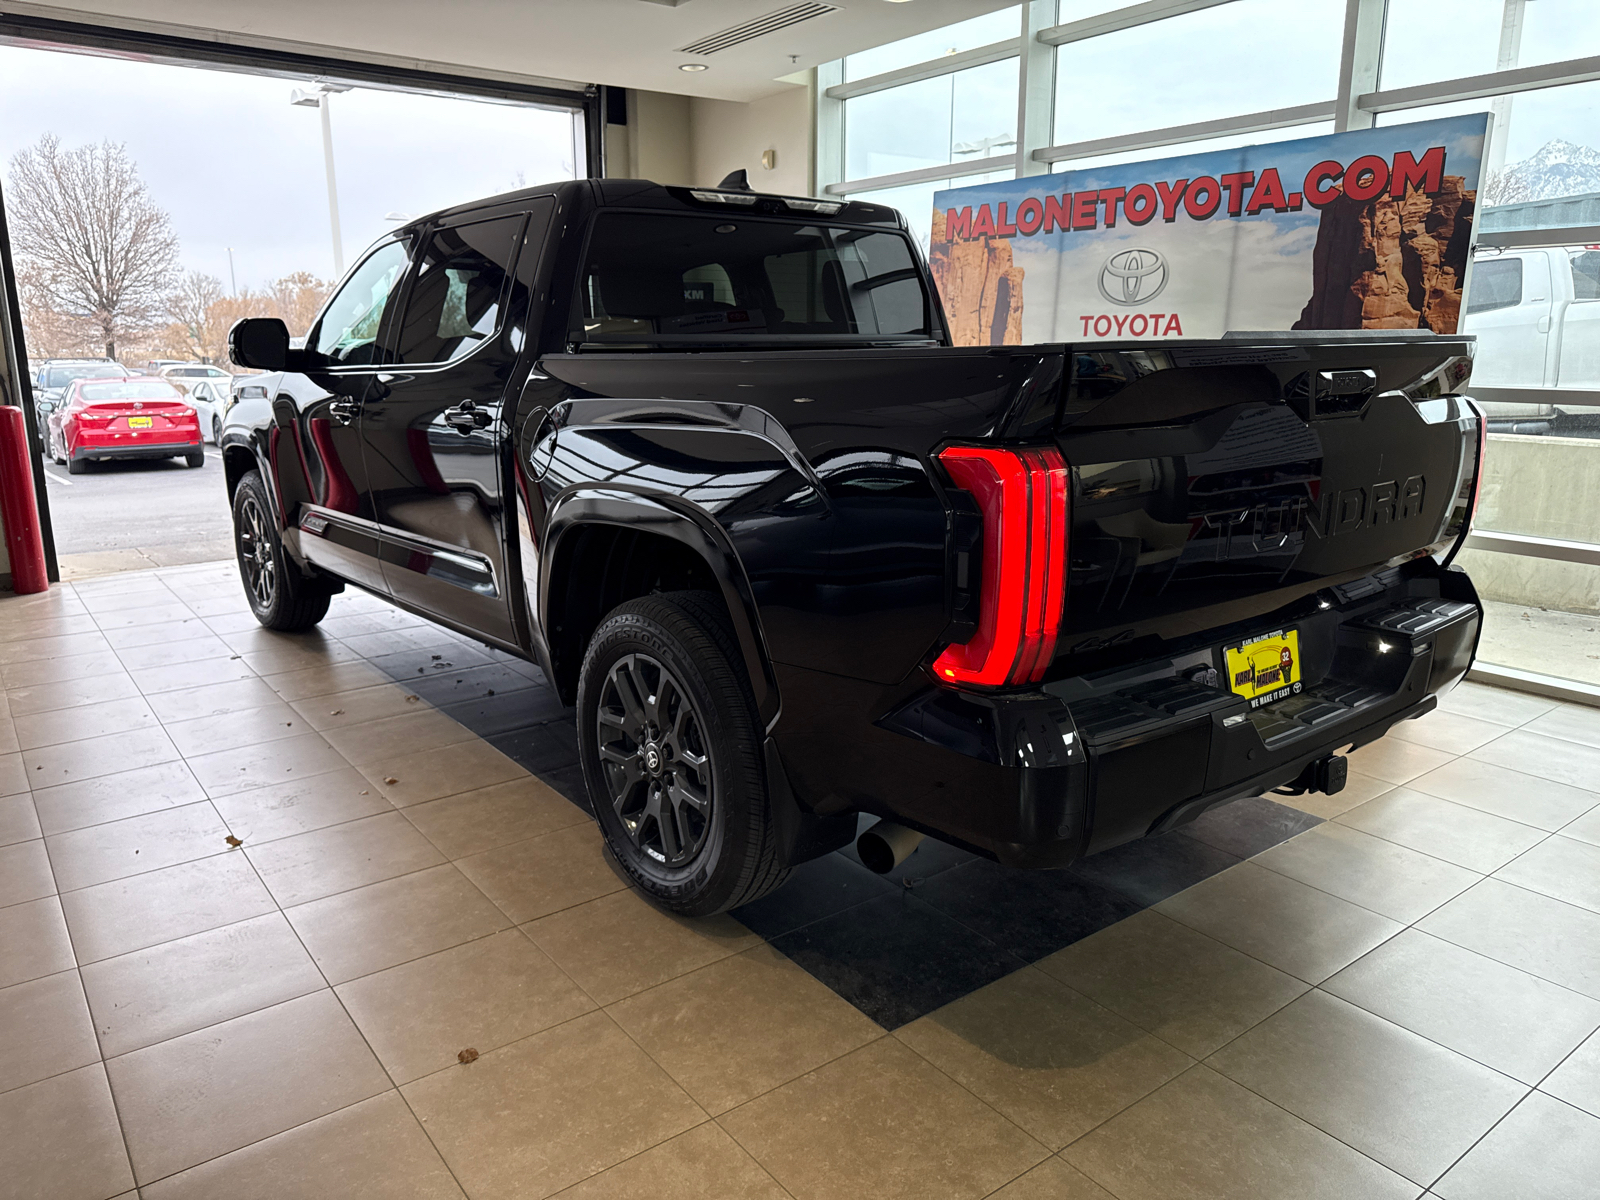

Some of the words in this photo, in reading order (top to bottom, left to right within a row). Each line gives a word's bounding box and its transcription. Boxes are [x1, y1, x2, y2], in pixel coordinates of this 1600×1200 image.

[945, 146, 1447, 244] MALONETOYOTA.COM
[1080, 313, 1183, 337] TOYOTA
[1203, 474, 1426, 563] TUNDRA
[1282, 651, 1289, 661] 32
[1235, 669, 1253, 688] KARL
[1256, 668, 1281, 689] MALONE
[1251, 699, 1259, 708] WE
[1260, 694, 1273, 705] MAKE
[1273, 691, 1278, 700] IT
[1279, 687, 1290, 698] EASY
